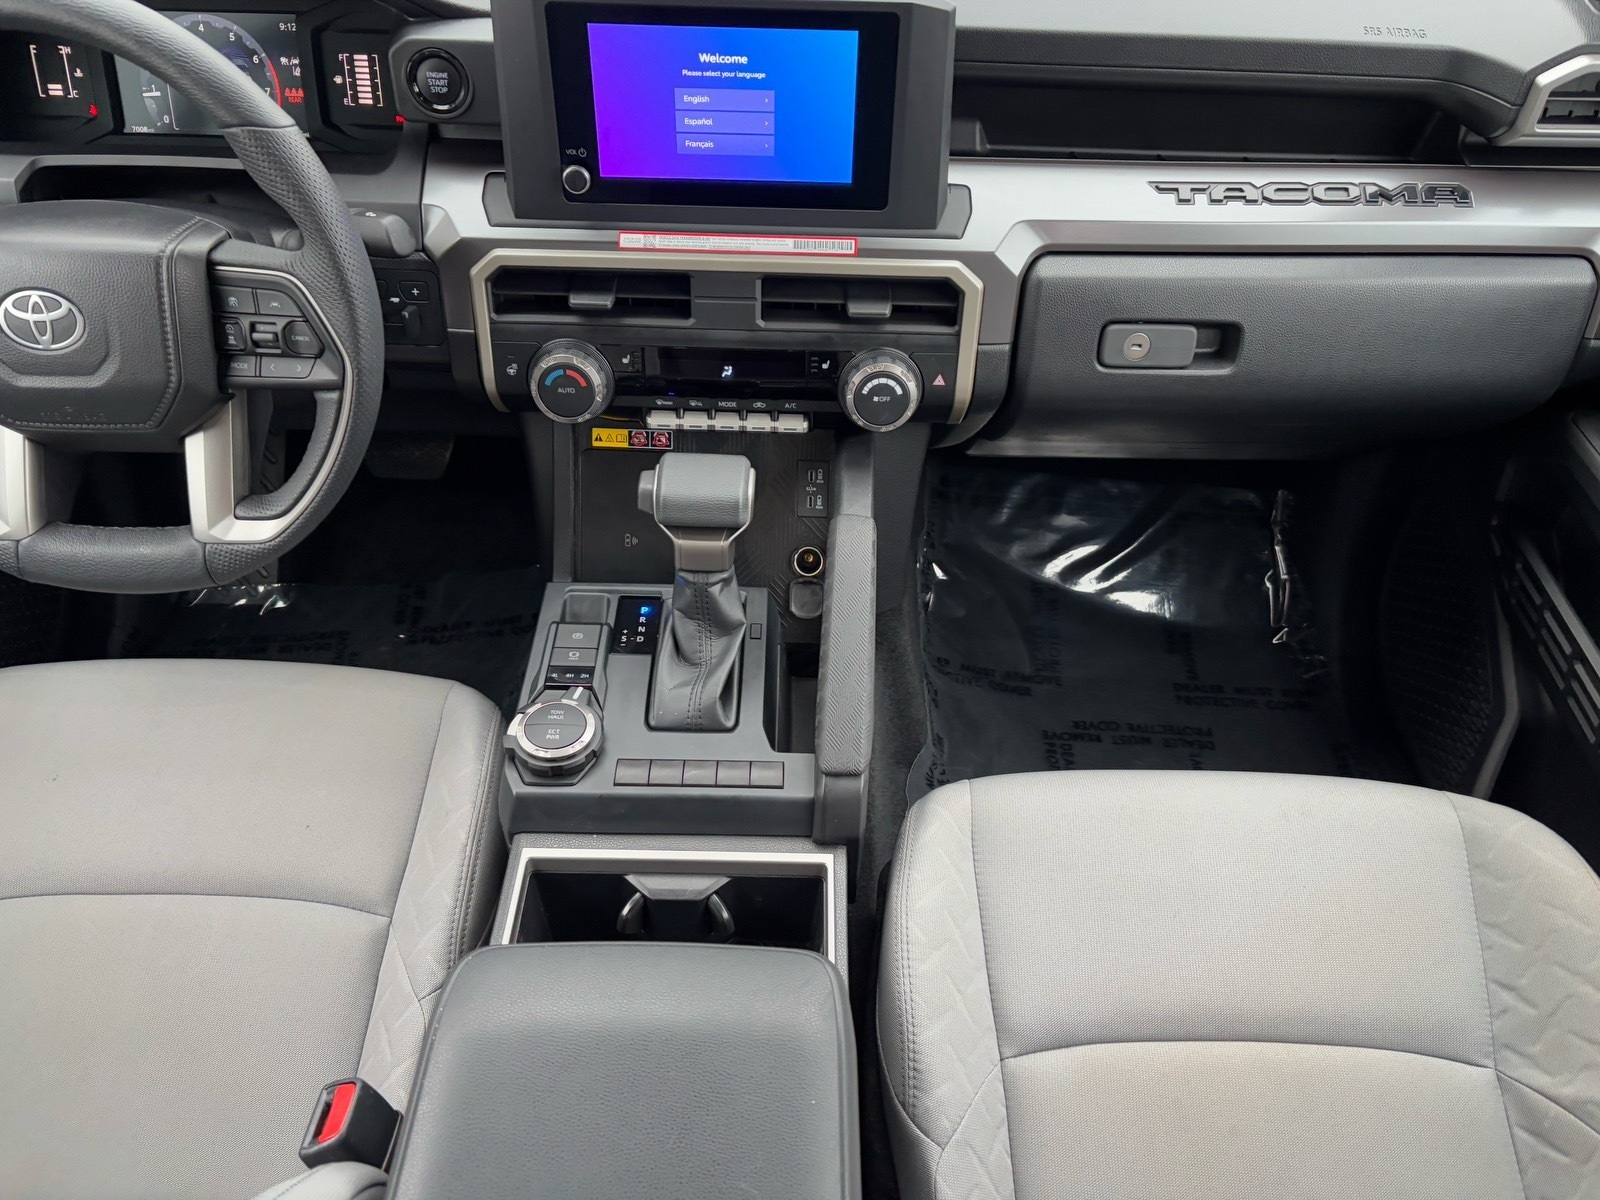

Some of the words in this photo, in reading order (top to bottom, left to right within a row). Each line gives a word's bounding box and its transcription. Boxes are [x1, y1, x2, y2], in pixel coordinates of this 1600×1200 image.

[198, 24, 204, 32] 4
[279, 23, 296, 31] 9:12
[1363, 25, 1382, 36] SRS
[1386, 27, 1428, 38] AIRBAG
[229, 33, 235, 41] 5
[253, 55, 259, 63] 6
[698, 53, 748, 64] Welcome
[426, 71, 448, 79] ENGINE
[682, 69, 702, 77] Please
[736, 71, 766, 79] language
[683, 95, 710, 104] English
[163, 115, 169, 123] 0
[684, 118, 713, 126] Español
[685, 140, 714, 149] Français
[1146, 180, 1475, 208] TACOMA
[230, 362, 248, 370] MODE
[640, 606, 648, 614] P
[1071, 720, 1121, 732] COVER
[1126, 722, 1213, 737] PROTECTIVE
[1041, 730, 1102, 744] REMOVE
[1162, 737, 1216, 751] DEALER
